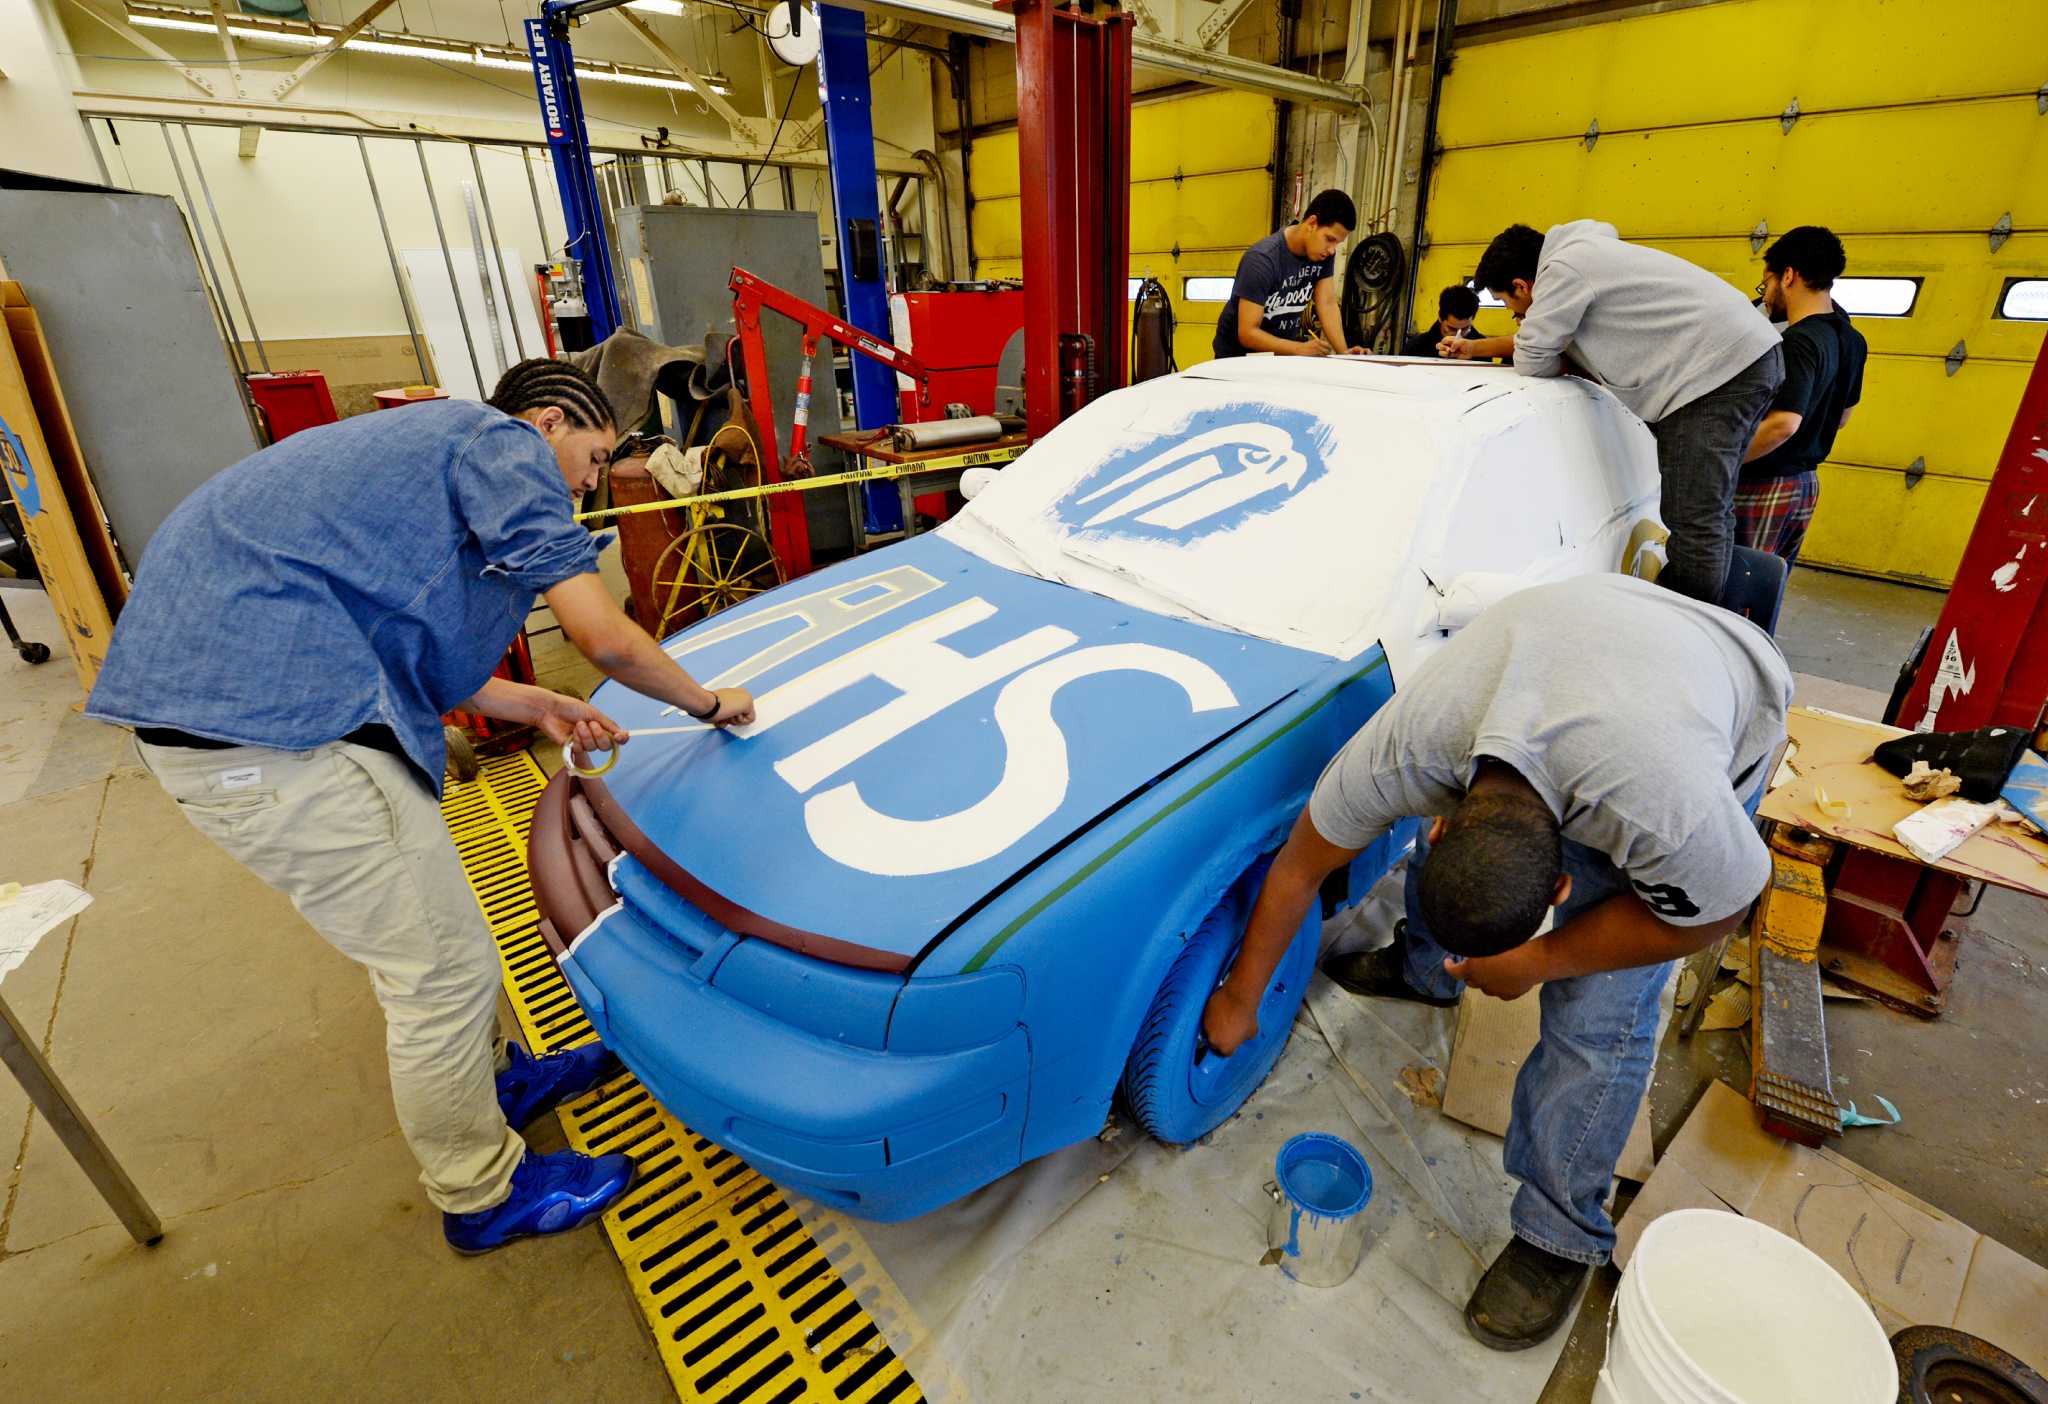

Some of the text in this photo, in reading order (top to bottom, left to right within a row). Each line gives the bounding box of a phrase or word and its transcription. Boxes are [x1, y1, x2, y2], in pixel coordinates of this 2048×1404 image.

[530, 21, 561, 128] ROTARY LIFT
[963, 452, 990, 465] CAUTION
